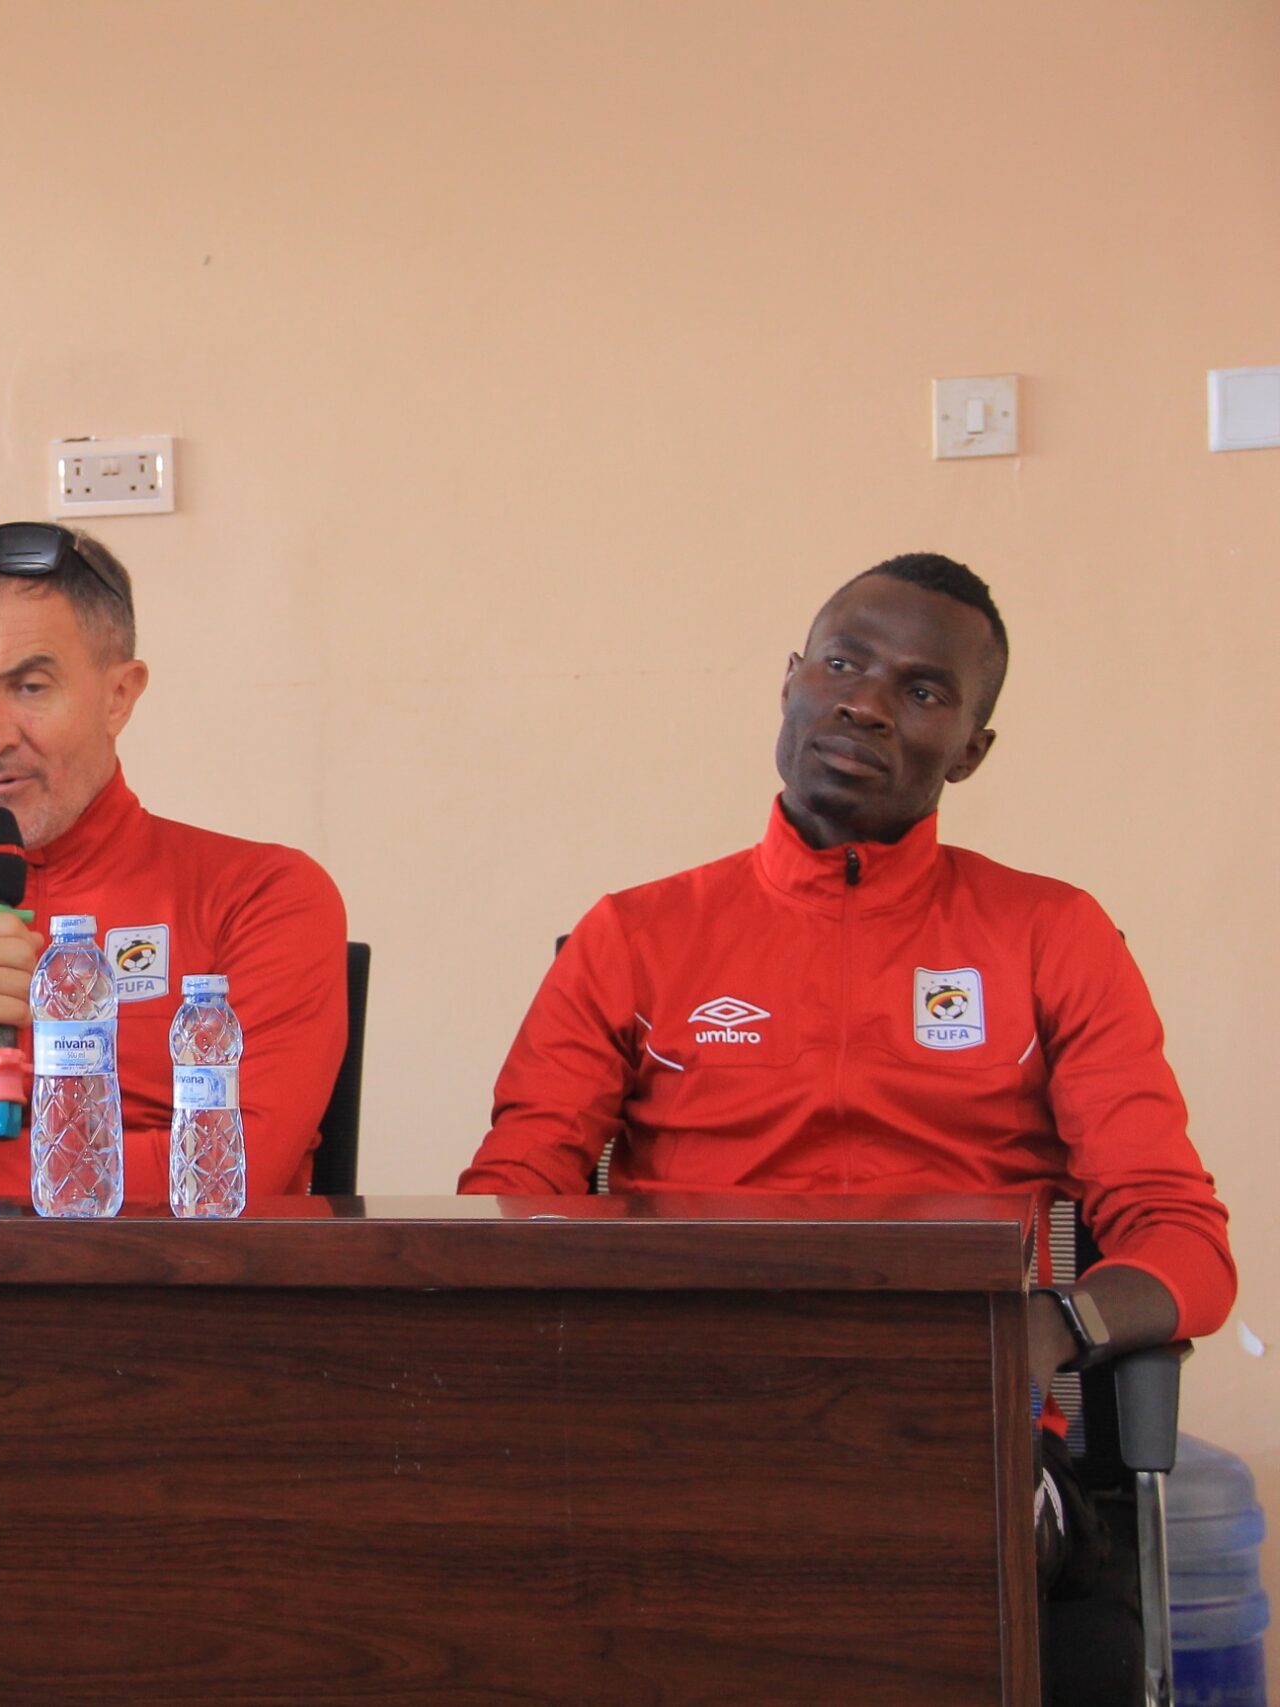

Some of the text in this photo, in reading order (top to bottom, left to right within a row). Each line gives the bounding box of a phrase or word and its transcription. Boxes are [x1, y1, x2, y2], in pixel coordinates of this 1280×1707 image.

[116, 980, 155, 994] FUFA
[695, 1027, 761, 1044] umbro
[927, 1029, 969, 1040] FUFA
[54, 1036, 95, 1049] nivana
